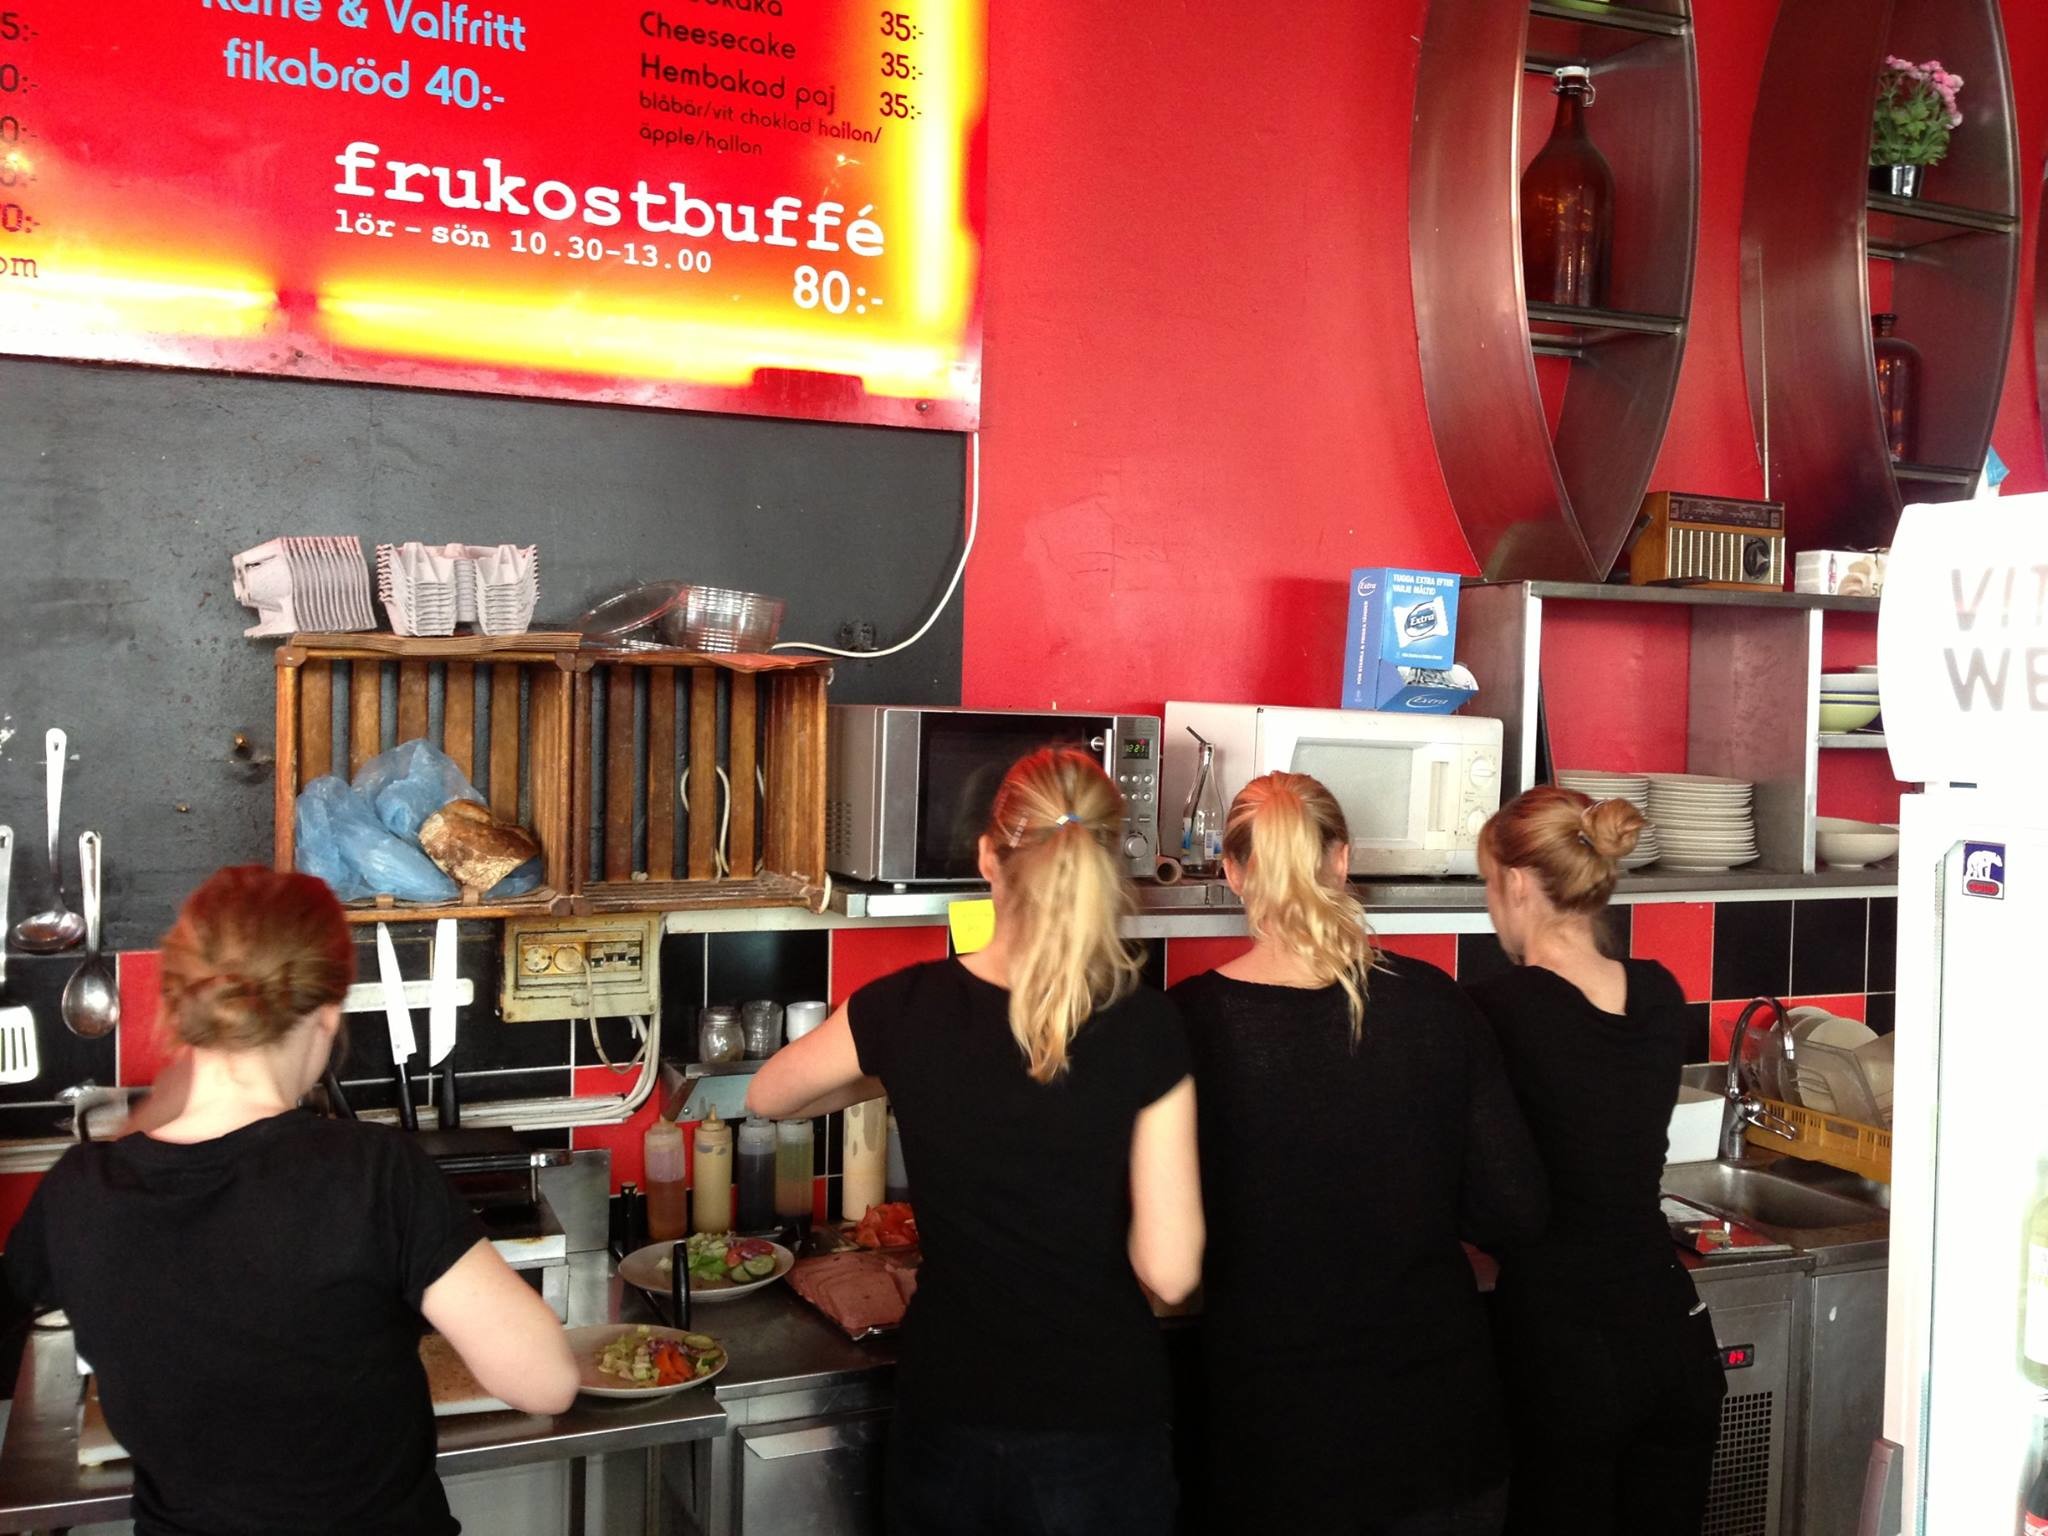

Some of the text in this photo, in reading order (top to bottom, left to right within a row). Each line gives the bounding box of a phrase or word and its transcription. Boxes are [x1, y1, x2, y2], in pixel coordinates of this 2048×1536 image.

[337, 0, 368, 29] &
[384, 0, 526, 51] Valfritt
[640, 10, 924, 59] Cheesecake 35:-
[223, 37, 505, 111] fikabröd 40:-
[640, 52, 923, 116] Hembakad paj 35:-
[740, 108, 812, 134] choklad
[879, 92, 922, 120] 35:-
[639, 123, 763, 155] äpple/hallon
[334, 141, 885, 257] frukostbuffé
[335, 208, 396, 238] lör
[431, 223, 491, 249] sön
[510, 229, 712, 274] 10.30-13.00
[792, 265, 884, 315] 80:-
[1410, 614, 1436, 627] Extra
